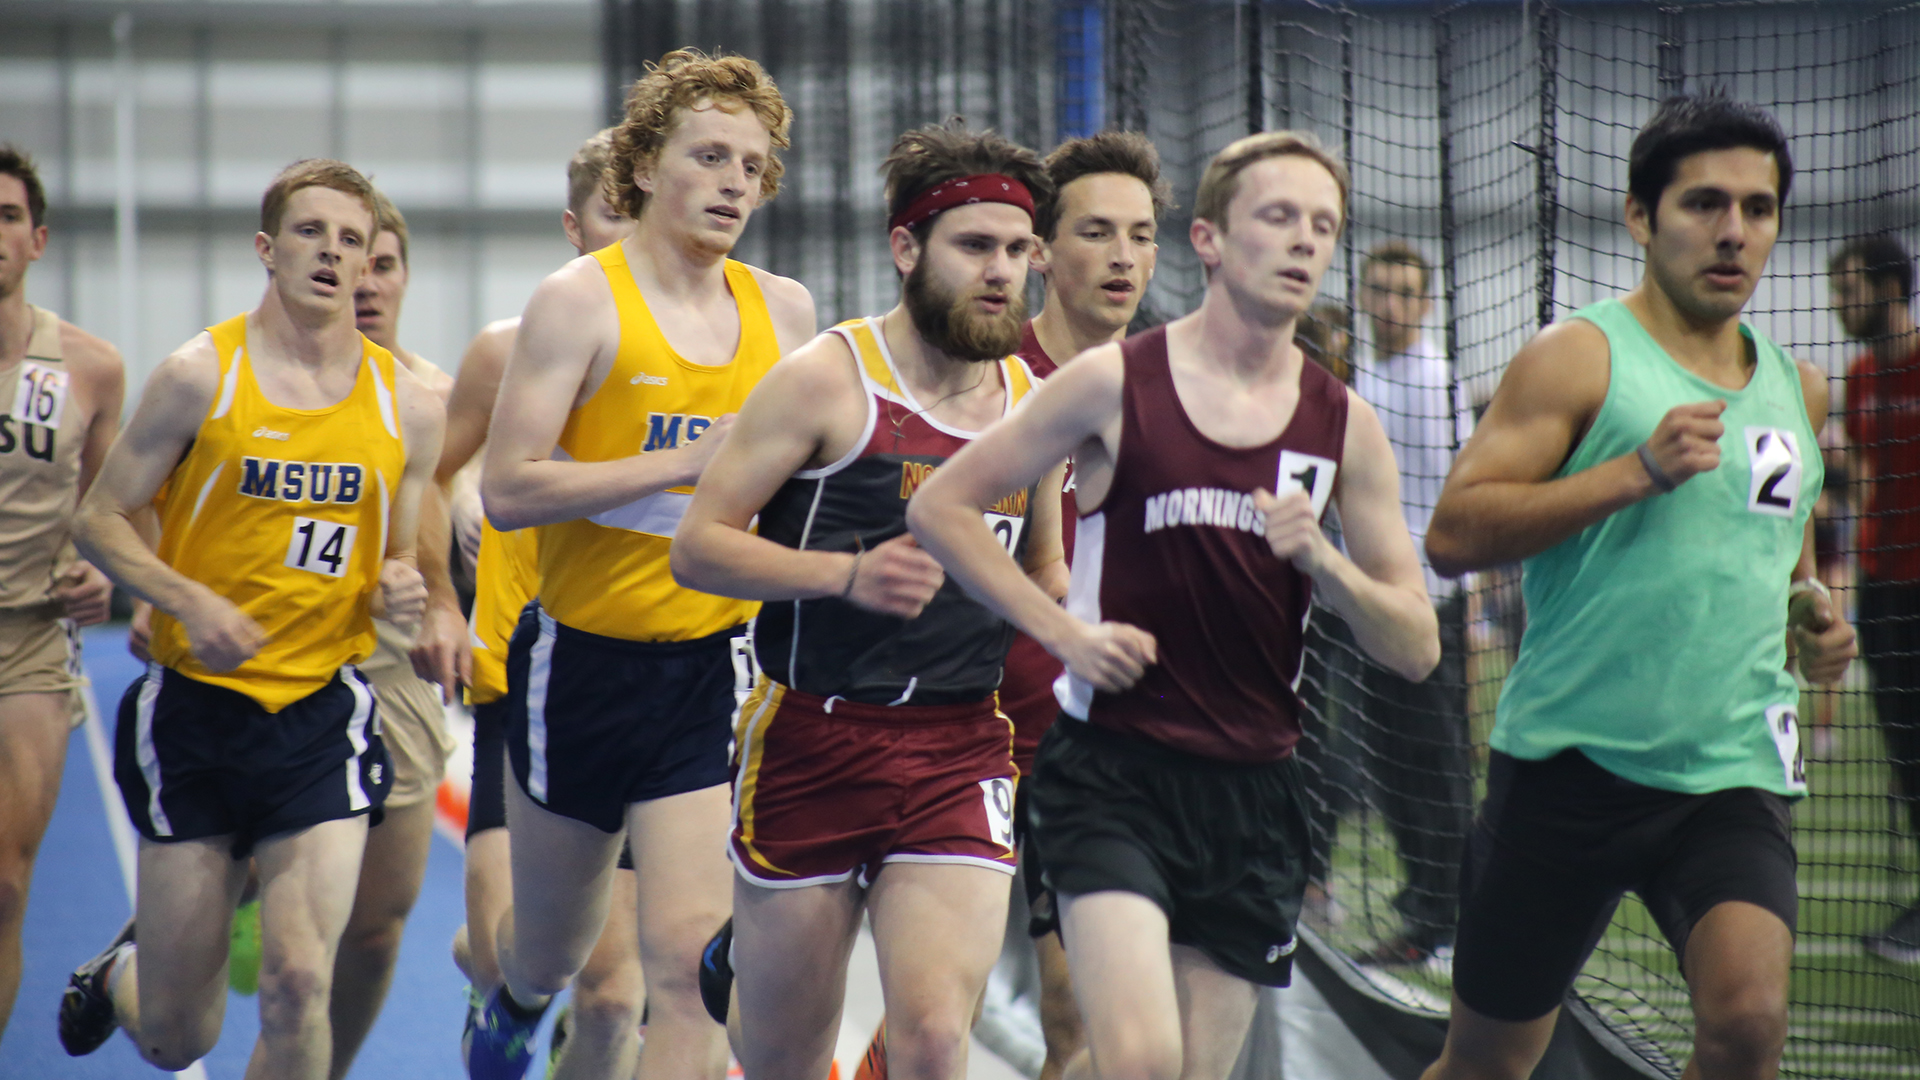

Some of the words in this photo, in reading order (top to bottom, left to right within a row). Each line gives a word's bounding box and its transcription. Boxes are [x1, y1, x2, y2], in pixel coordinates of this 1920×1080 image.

[24, 368, 55, 422] 16
[237, 456, 366, 504] MSUB
[1756, 432, 1792, 509] 2
[1144, 487, 1267, 537] MORNINGS
[297, 520, 346, 573] 14
[1778, 712, 1806, 783] 2
[991, 779, 1012, 845] 9
